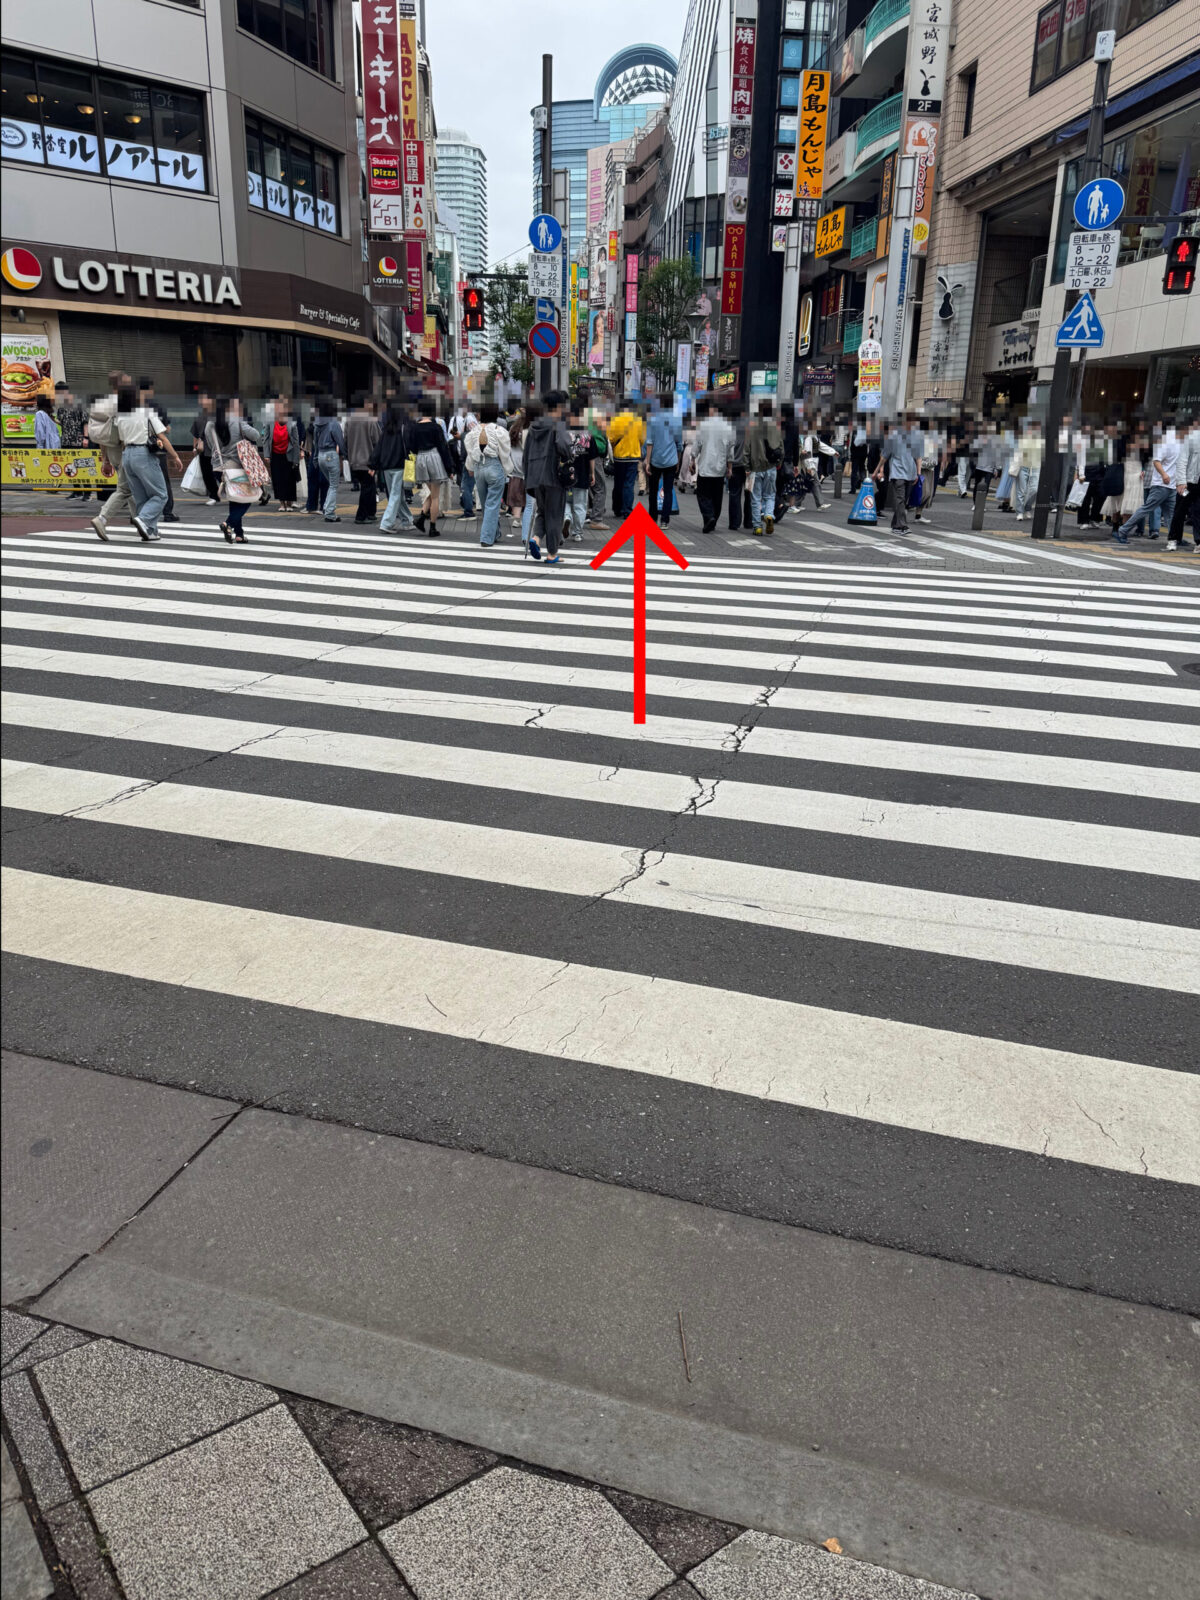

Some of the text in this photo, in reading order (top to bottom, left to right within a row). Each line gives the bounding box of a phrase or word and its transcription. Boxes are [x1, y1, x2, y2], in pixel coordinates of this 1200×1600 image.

[368, 0, 399, 146] ェーキーズ
[918, 101, 932, 111] 2F
[801, 74, 827, 178] 月島もんじゃ
[406, 141, 419, 182] 中国語
[384, 216, 398, 226] B1
[53, 256, 242, 306] LOTTERIA
[300, 304, 318, 320] Burger
[3, 345, 46, 356] AVOCADO
